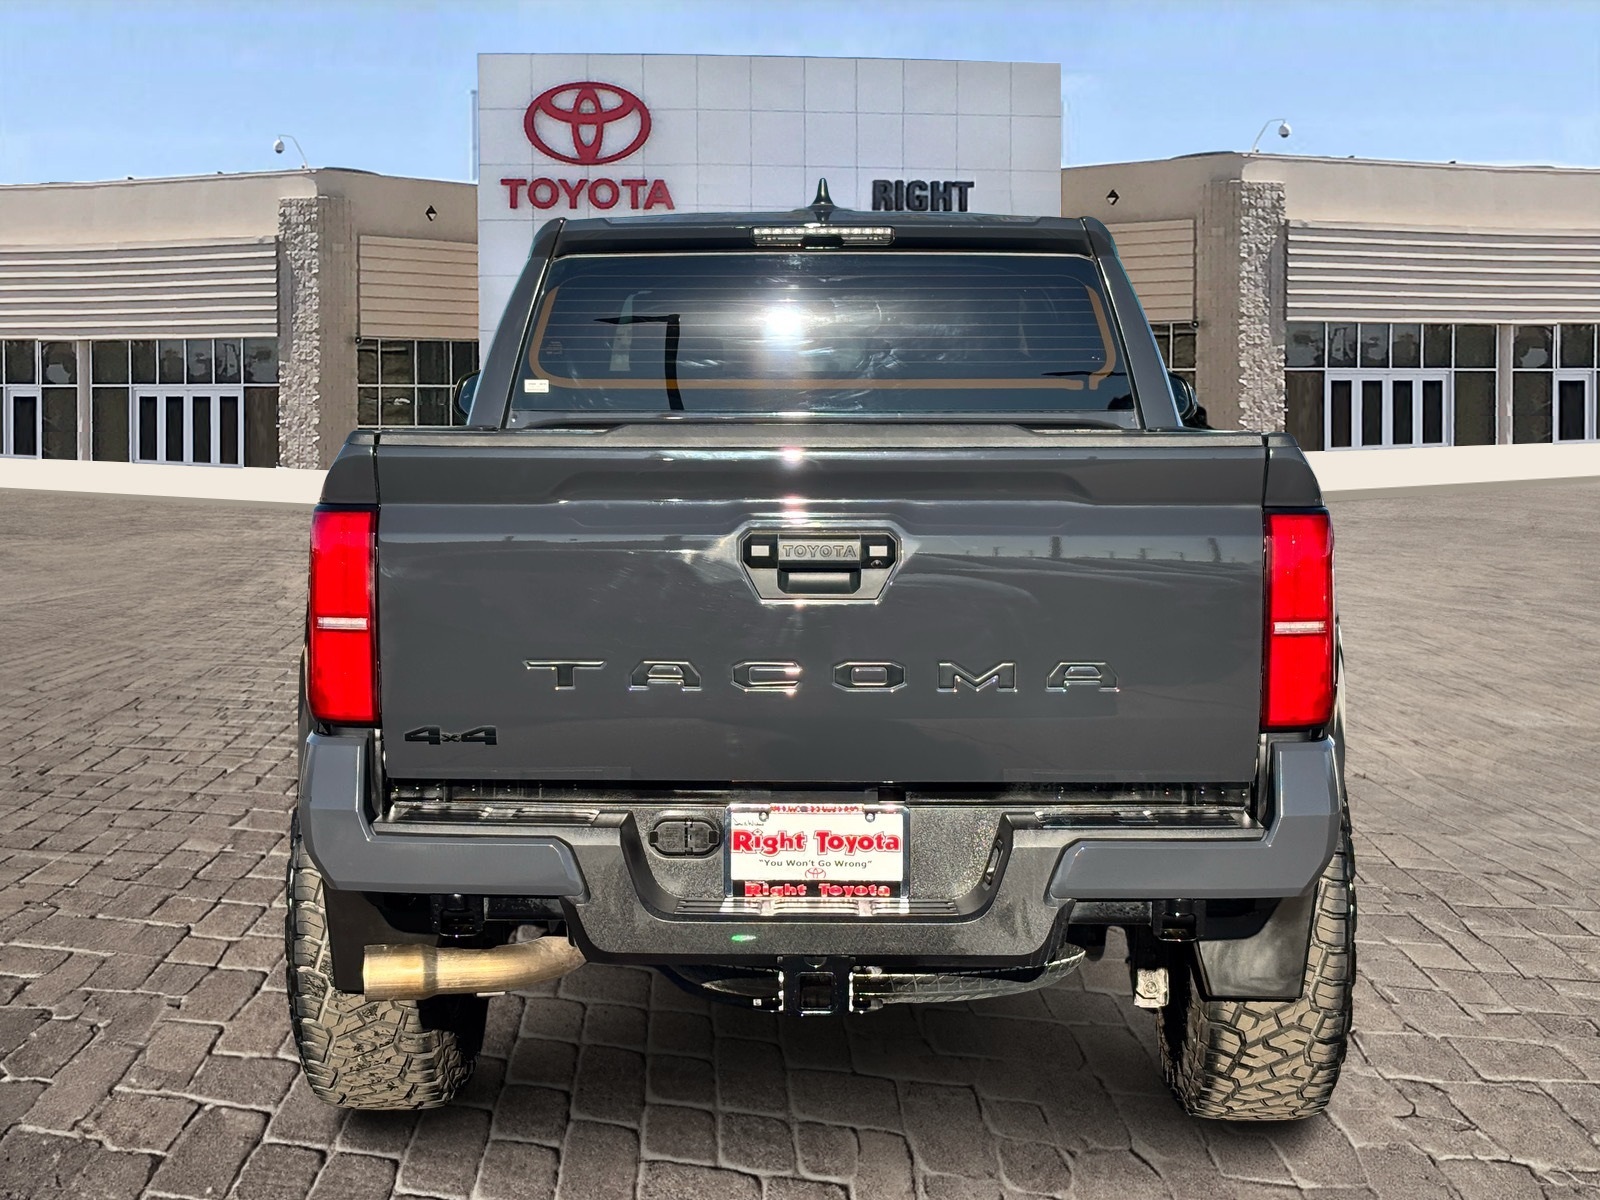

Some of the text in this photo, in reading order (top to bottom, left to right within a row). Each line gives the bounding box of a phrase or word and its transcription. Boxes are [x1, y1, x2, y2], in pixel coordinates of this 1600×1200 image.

[500, 177, 675, 210] TOYOTA
[872, 179, 975, 212] RIGHT
[782, 544, 857, 558] TOYOTA
[522, 659, 1121, 692] TACOMA
[404, 724, 498, 746] 4x4
[731, 829, 902, 856] Right Toyota
[786, 859, 815, 867] Won't
[818, 859, 832, 867] Go
[744, 881, 891, 897] Right Toyota
